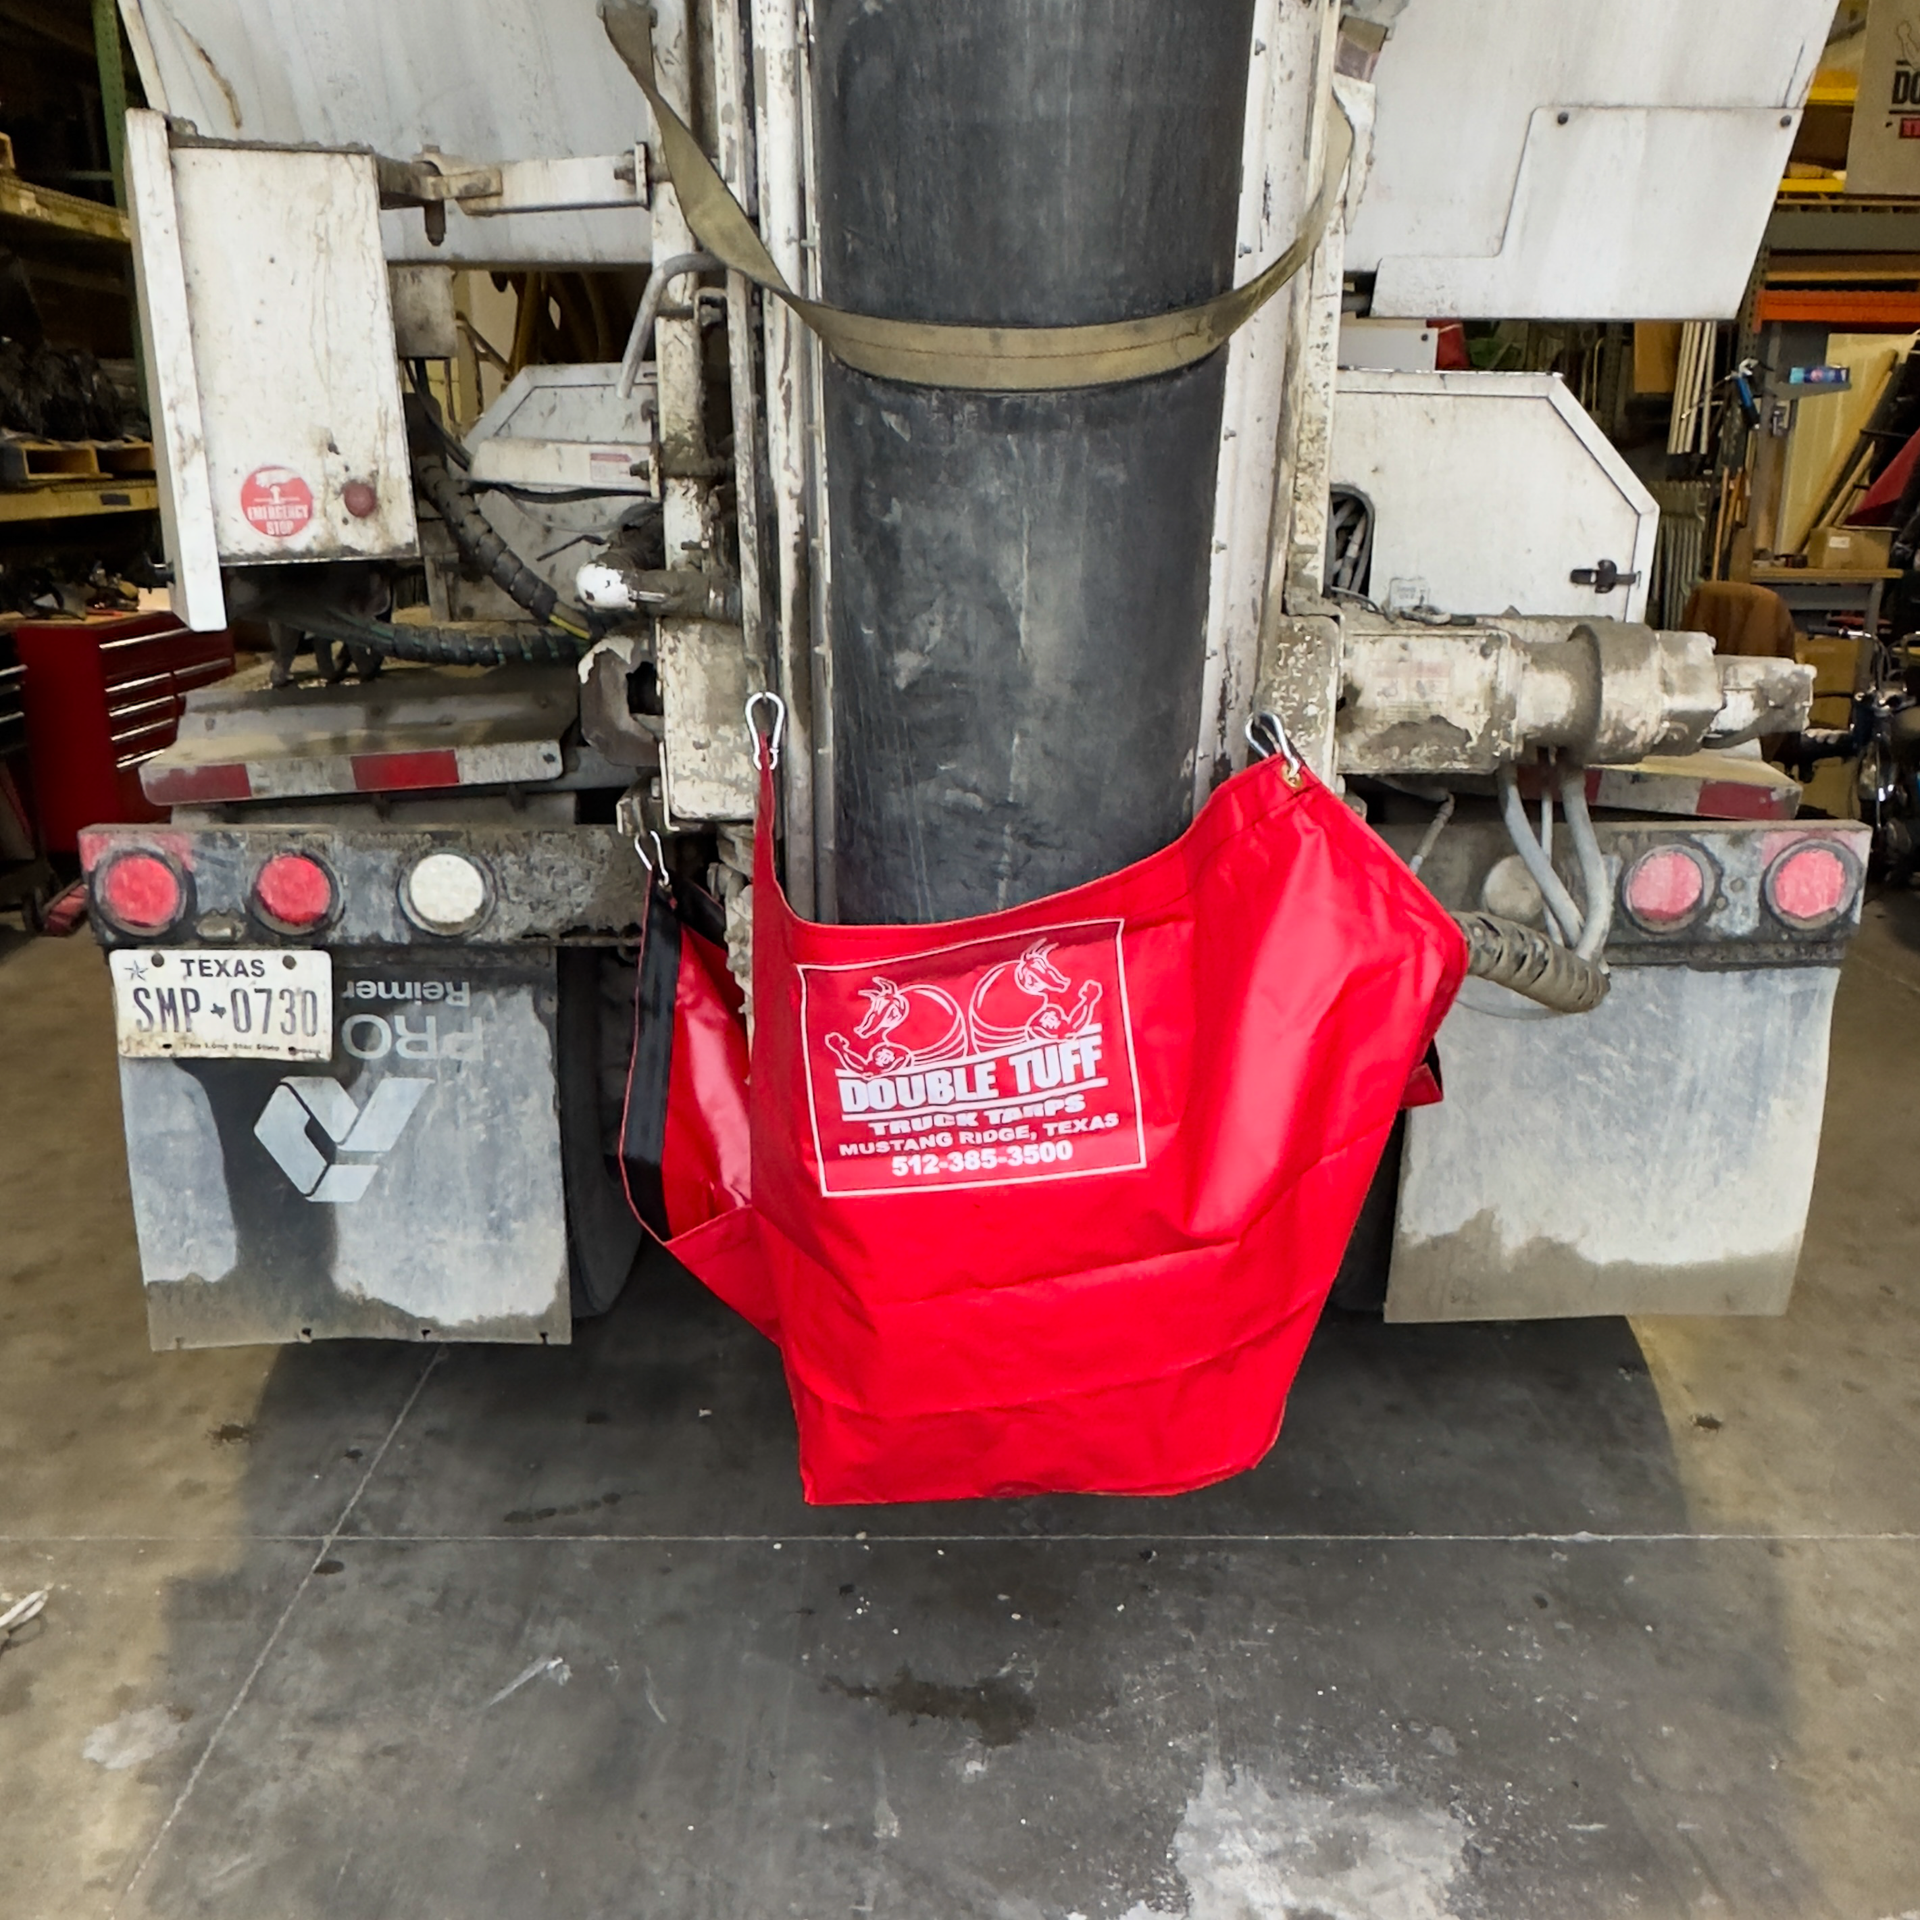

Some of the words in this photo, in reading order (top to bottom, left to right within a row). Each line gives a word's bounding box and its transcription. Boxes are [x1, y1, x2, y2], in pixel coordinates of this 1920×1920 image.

[266, 520, 294, 535] STOP
[180, 959, 266, 978] TEXAS
[132, 987, 201, 1033] SMP
[230, 987, 318, 1037] 0730
[341, 980, 470, 1007] Reimer
[341, 1013, 484, 1061] PRO
[838, 1061, 1000, 1113] DOUBLE
[1008, 1035, 1103, 1094] TUFF
[838, 1131, 953, 1157] MUSTANG
[959, 1124, 1037, 1145] RIDGE,
[1042, 1112, 1120, 1137] TEXAS
[868, 1111, 979, 1136] TRUCK
[891, 1139, 1074, 1178] 512-385-3500
